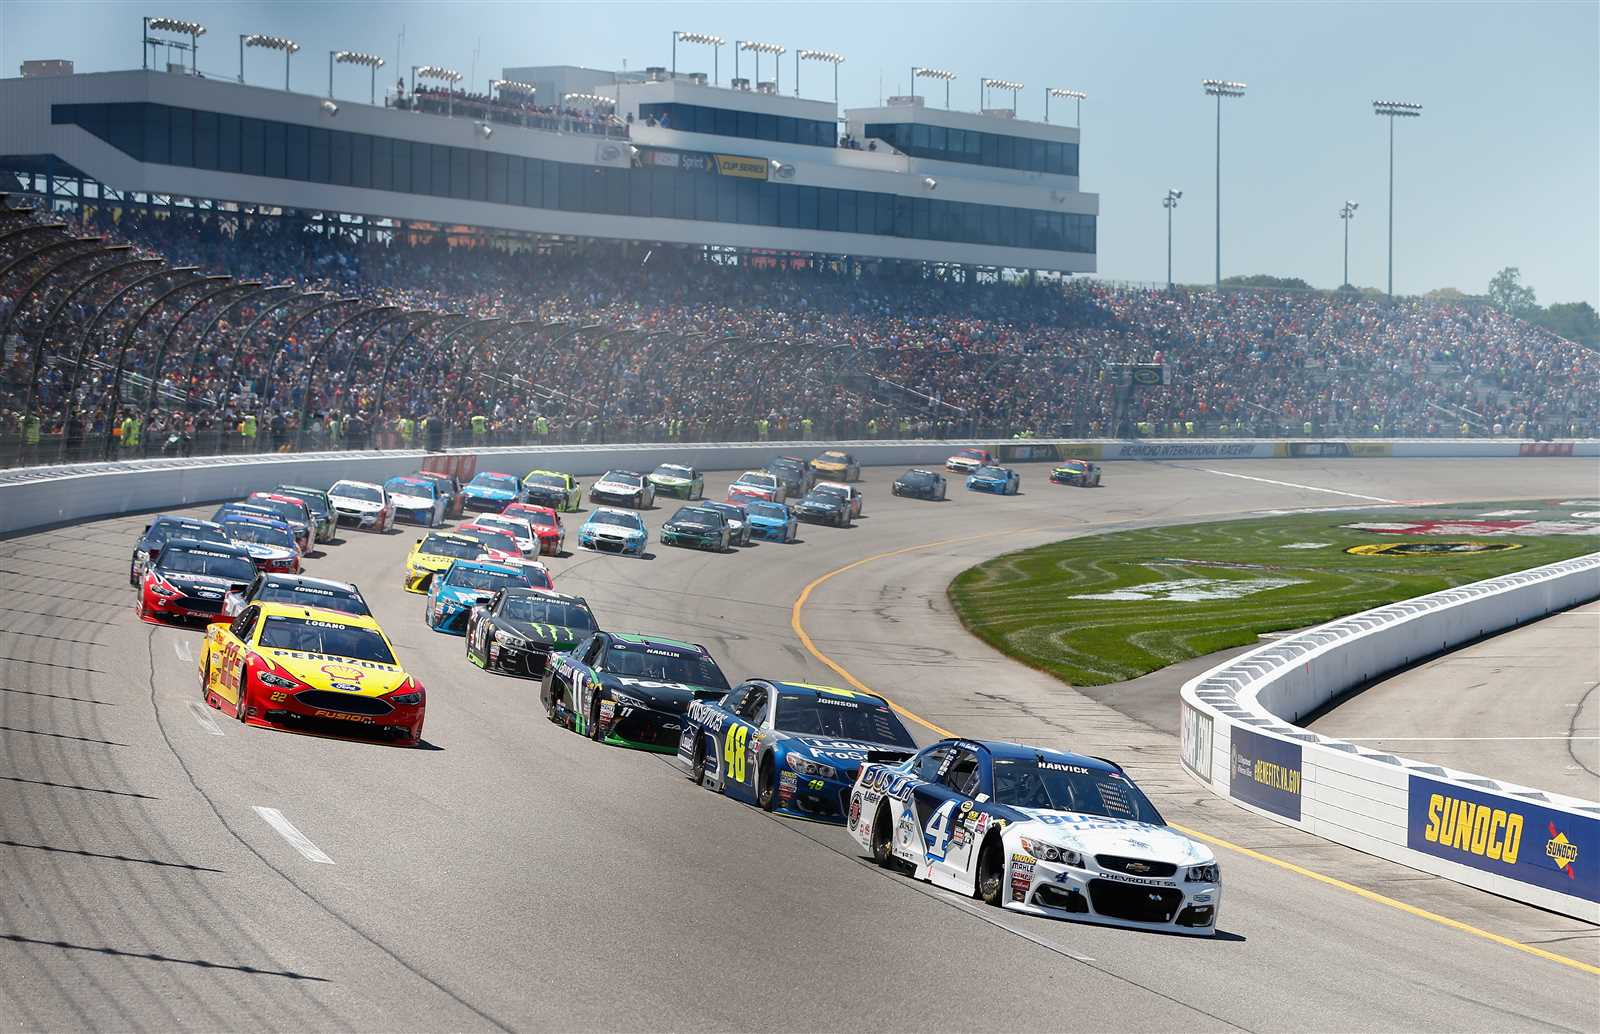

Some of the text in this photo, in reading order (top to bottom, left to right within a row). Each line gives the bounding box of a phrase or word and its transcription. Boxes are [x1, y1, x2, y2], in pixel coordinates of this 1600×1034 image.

[1161, 445, 1218, 456] INTERNATIONAL
[294, 586, 334, 597] EDWARDS
[305, 619, 346, 631] LOGANO
[646, 648, 680, 658] HAMLIN
[273, 650, 401, 673] PENNZOIL
[335, 682, 357, 691] Ford
[270, 692, 288, 703] 22
[818, 698, 859, 709] JOHNSON
[314, 709, 373, 723] FUSION
[620, 706, 638, 718] 11
[725, 722, 748, 783] 48
[1037, 761, 1089, 775] HARVICK
[807, 779, 825, 791] 48
[925, 799, 958, 861] 4
[1425, 793, 1524, 865] SUNOCO
[1547, 841, 1577, 861] SUNOCO
[1012, 862, 1034, 873] MAHLE
[1055, 871, 1069, 884] 4
[1099, 872, 1161, 887] CHEVROLET
